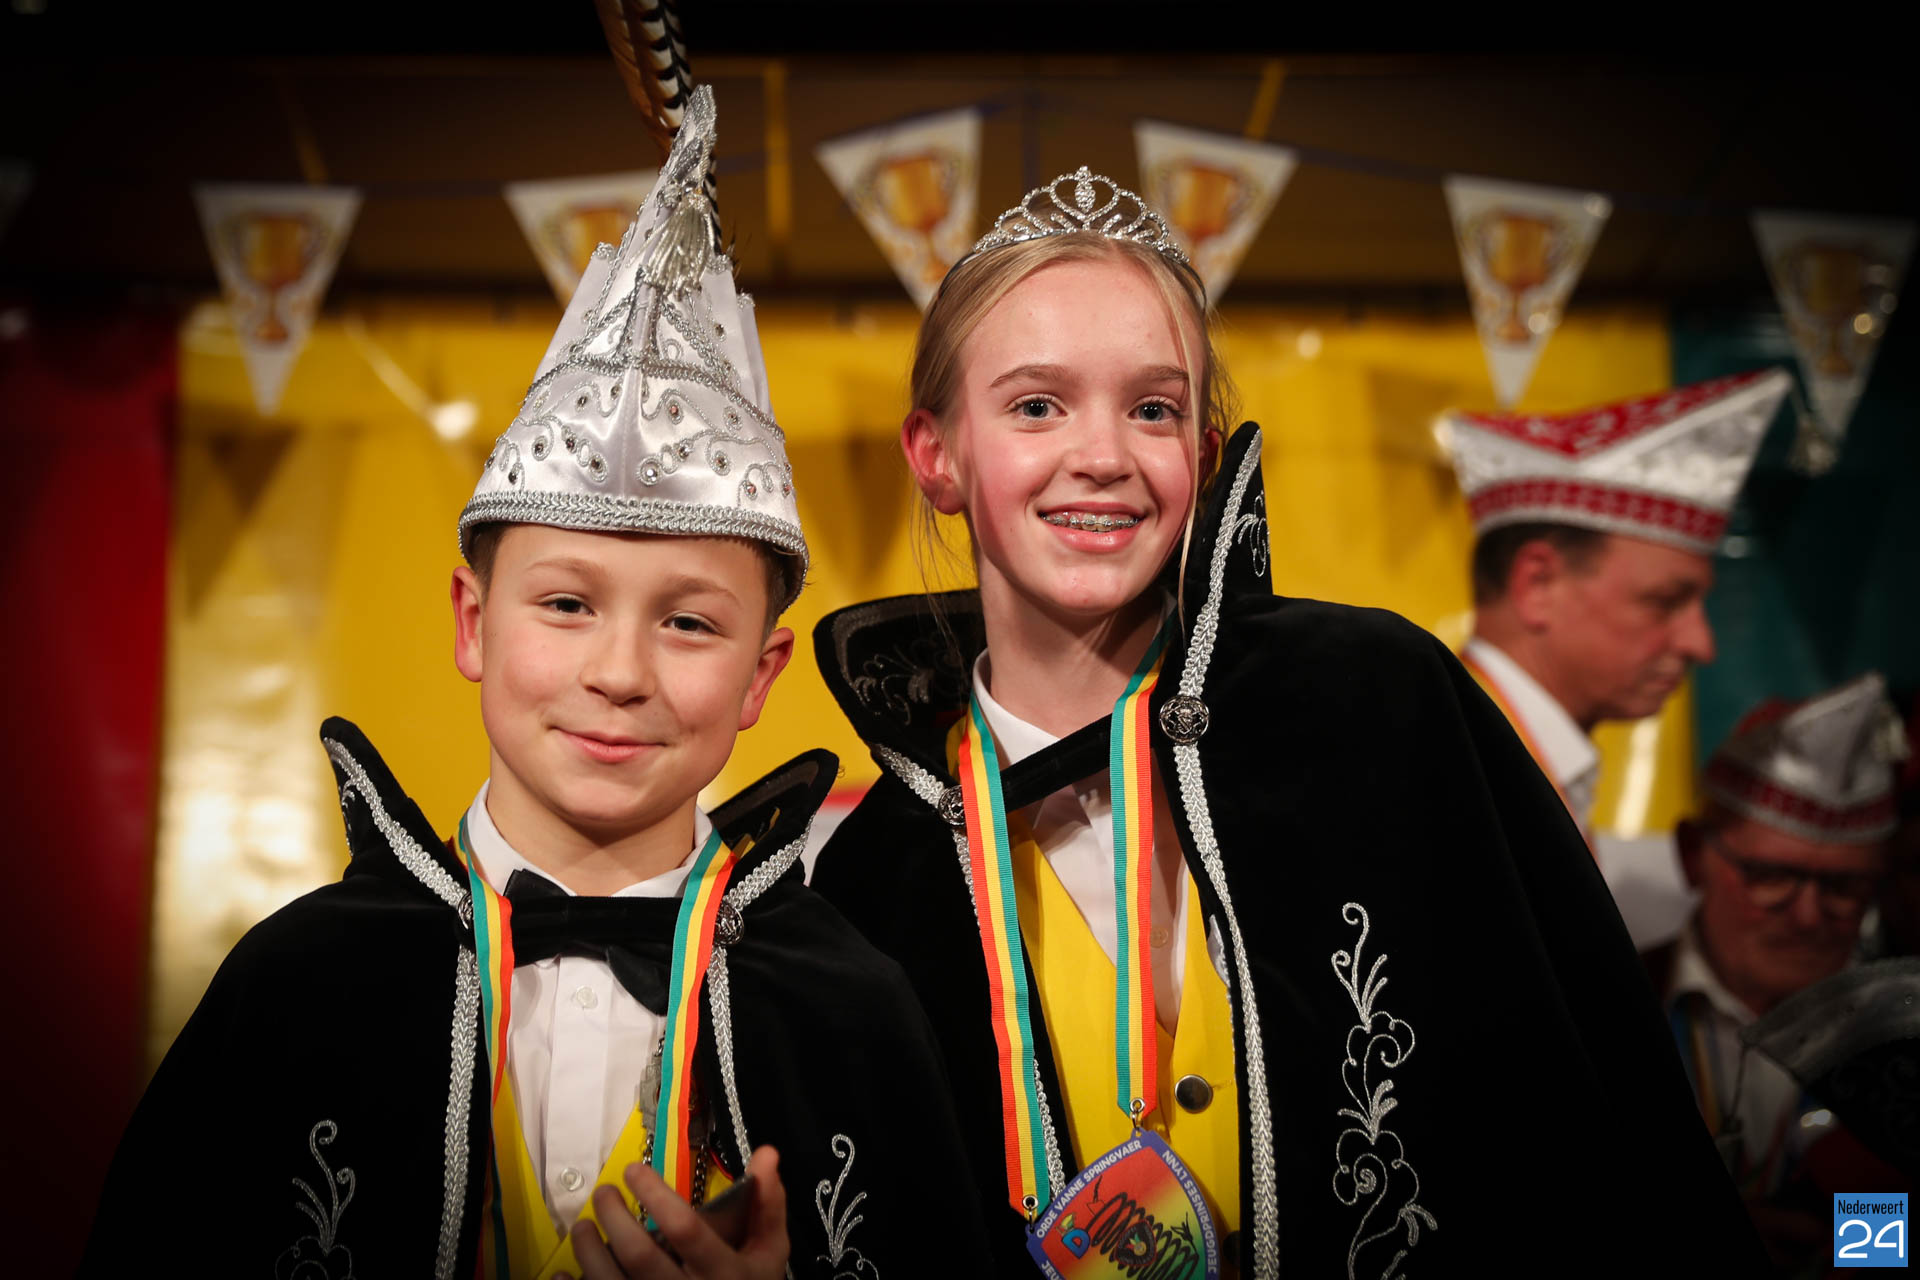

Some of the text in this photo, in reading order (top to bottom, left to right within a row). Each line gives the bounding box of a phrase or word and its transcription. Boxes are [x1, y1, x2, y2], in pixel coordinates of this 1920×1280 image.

[1037, 1140, 1142, 1238] ORDE VANNE SPRINGVAER
[1162, 1150, 1217, 1273] JEUGDPRINSES LYNN
